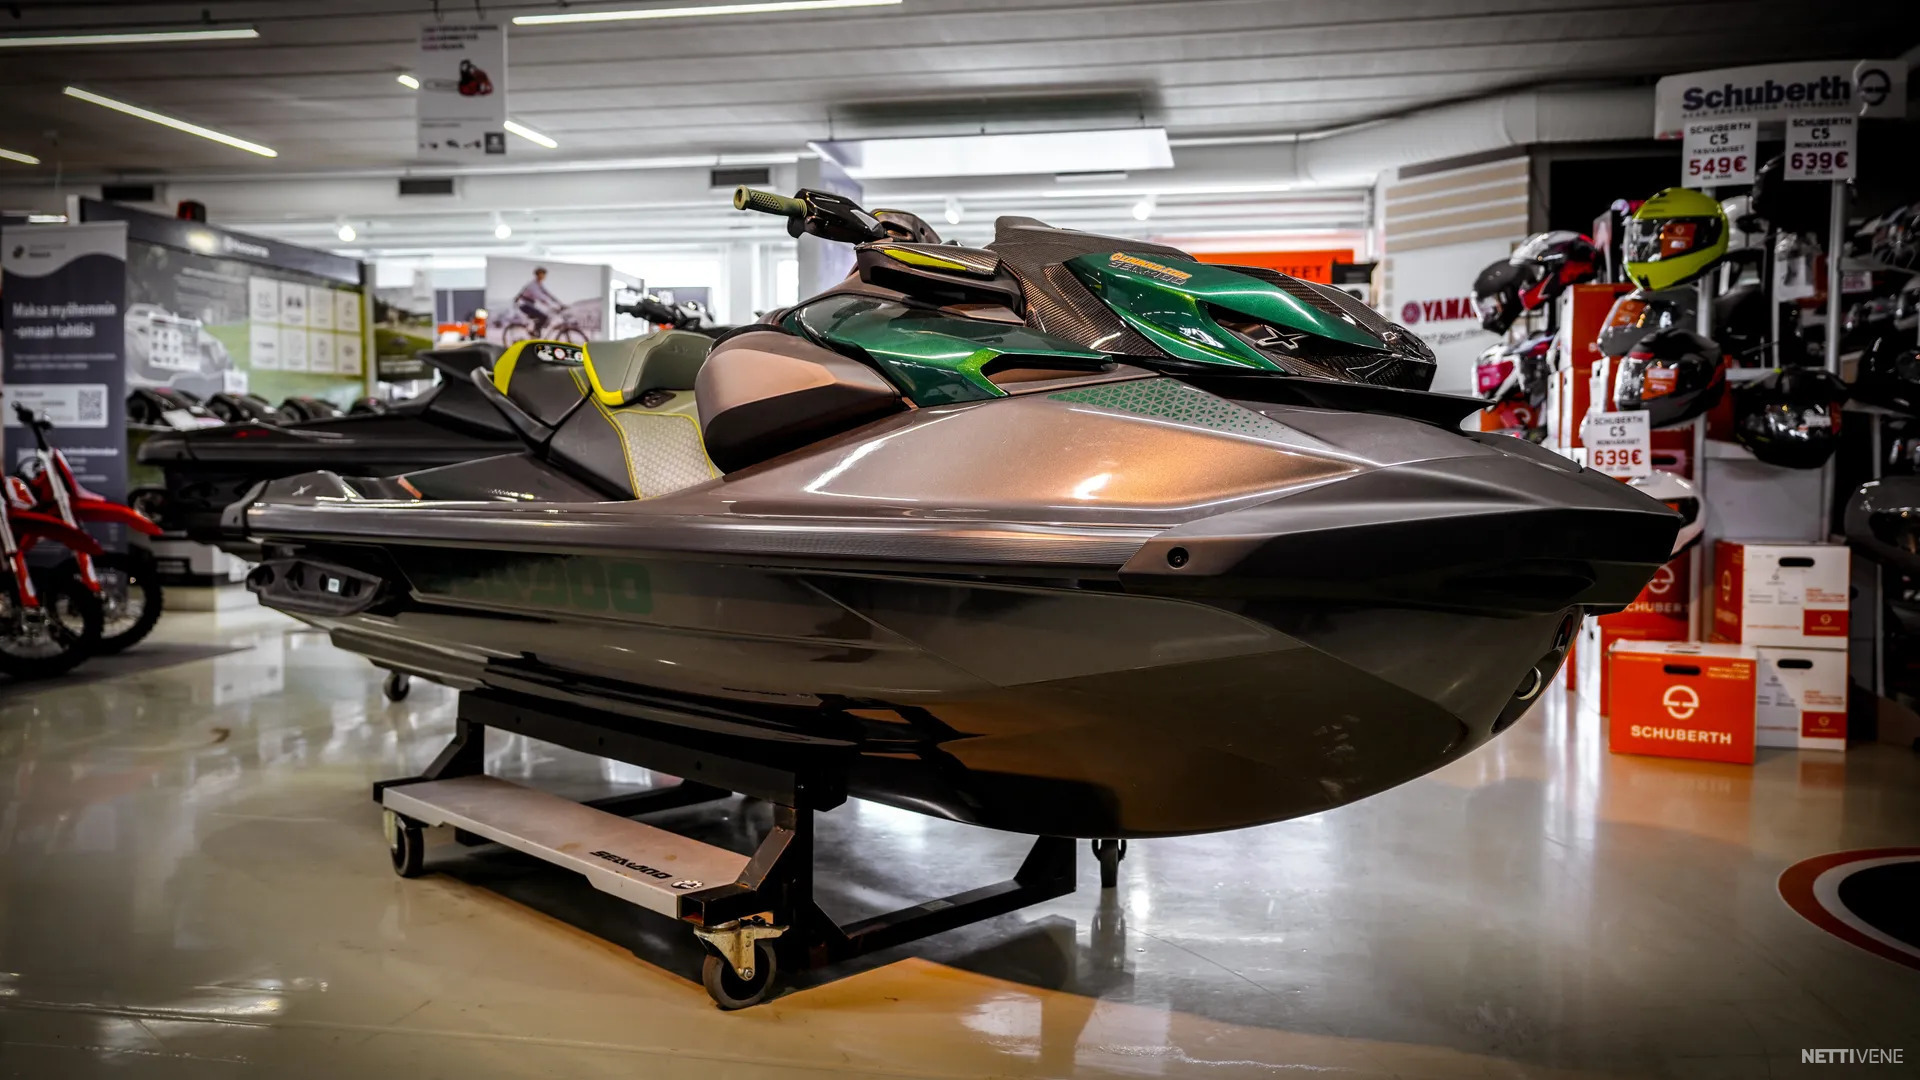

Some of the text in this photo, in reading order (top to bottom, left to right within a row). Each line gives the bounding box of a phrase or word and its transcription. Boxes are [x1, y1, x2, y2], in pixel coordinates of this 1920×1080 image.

[1682, 76, 1851, 111] Schuberth
[1690, 122, 1751, 135] SCHUBERTH
[1792, 116, 1852, 128] SCHUBERTH
[1709, 132, 1729, 145] C5
[1811, 127, 1830, 139] C5
[1689, 155, 1747, 176] 549€
[1791, 150, 1849, 170] 639€
[1422, 297, 1477, 322] YAMA
[1594, 415, 1644, 425] SCHUBERTH
[1609, 426, 1626, 437] C5
[1594, 449, 1643, 466] 639€
[1631, 724, 1732, 745] SCHUBERTH
